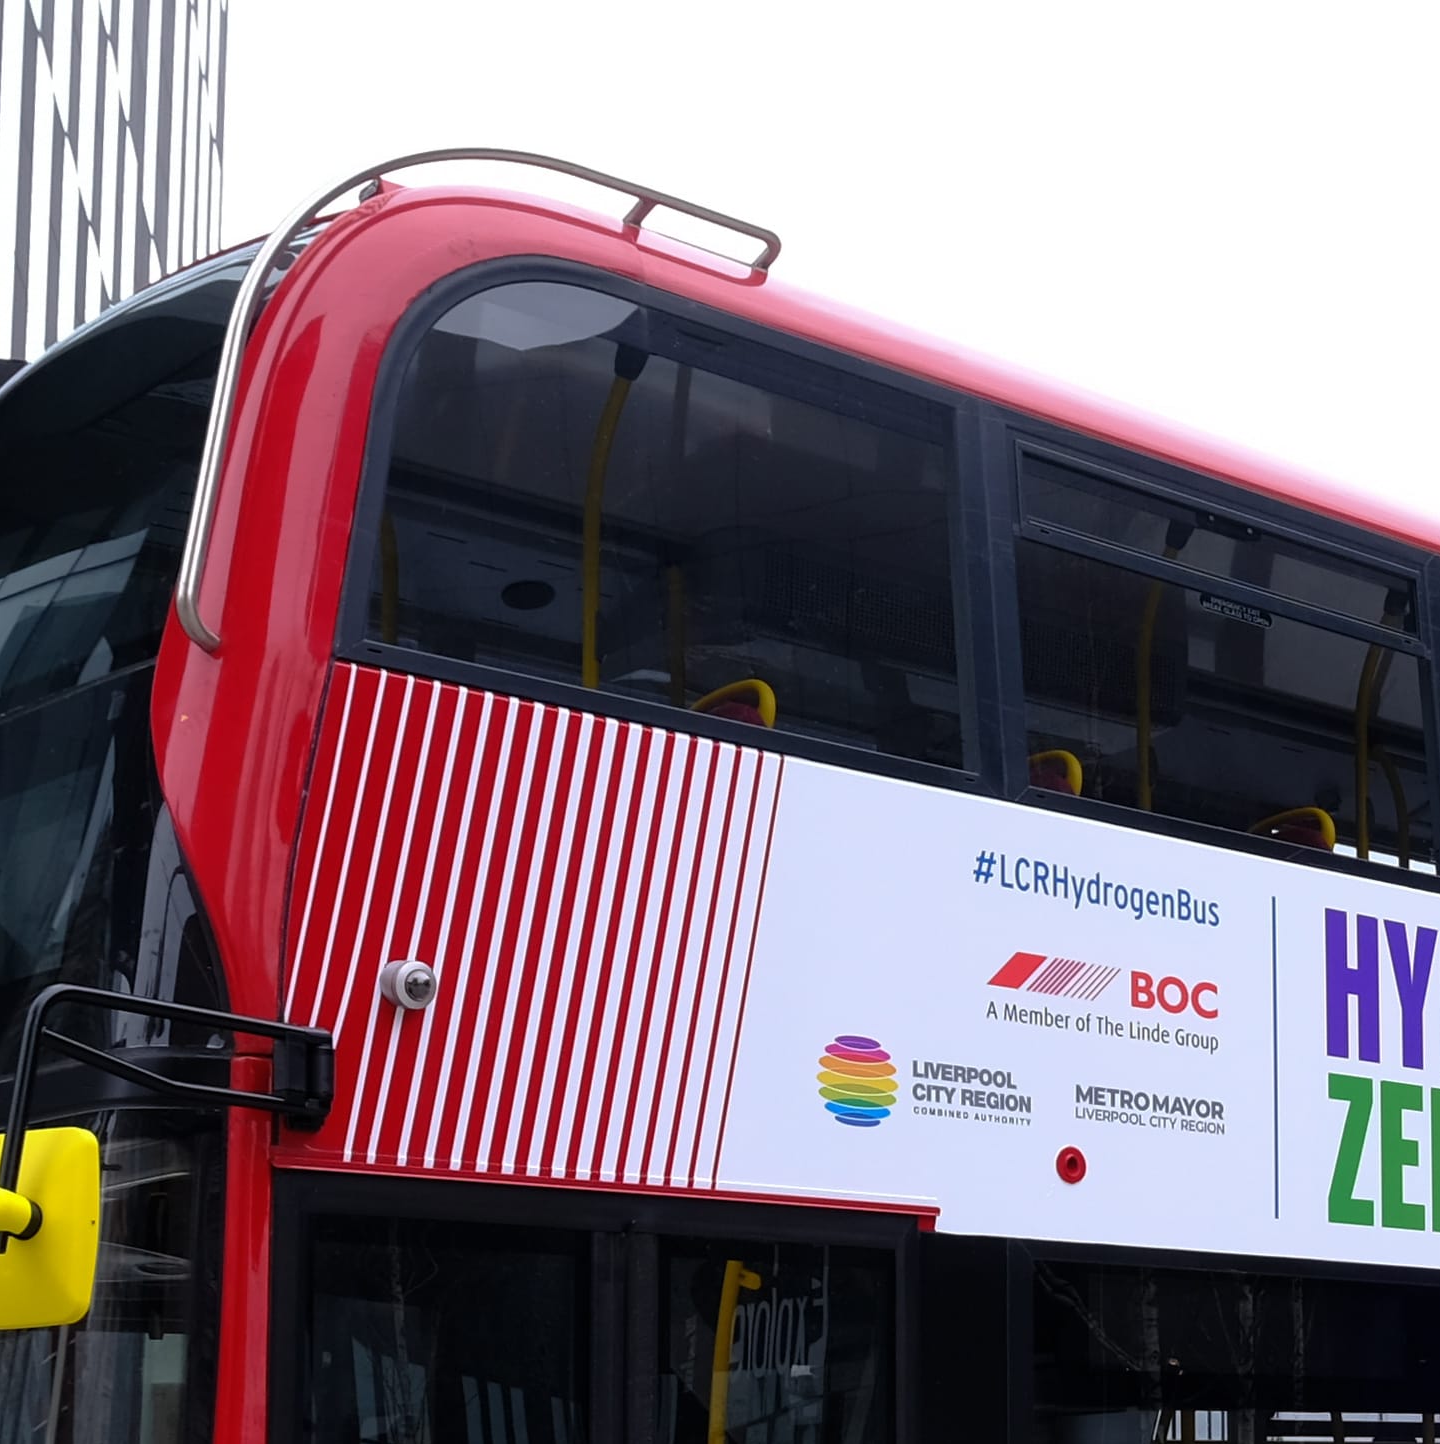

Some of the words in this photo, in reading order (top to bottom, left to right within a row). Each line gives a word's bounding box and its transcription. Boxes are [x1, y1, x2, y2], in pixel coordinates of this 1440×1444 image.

[973, 850, 1220, 927] #LCRHydrogenBus
[1130, 970, 1219, 1019] BOC
[986, 1001, 998, 1020] A
[1003, 1003, 1071, 1030] Member
[1075, 1013, 1092, 1033] of
[1096, 1016, 1124, 1037] The
[1129, 1022, 1170, 1044] Linde
[1175, 1028, 1219, 1055] Group
[912, 1060, 1017, 1089] LIVERPOOL
[912, 1083, 956, 1104] CITY
[961, 1089, 1031, 1113] REGION
[913, 1106, 969, 1119] COMBINED
[974, 1113, 1031, 1126] AUTHORITY
[1075, 1107, 1146, 1126] LIVERPOOL
[1149, 1116, 1177, 1130] CITY
[1181, 1119, 1225, 1135] REGION
